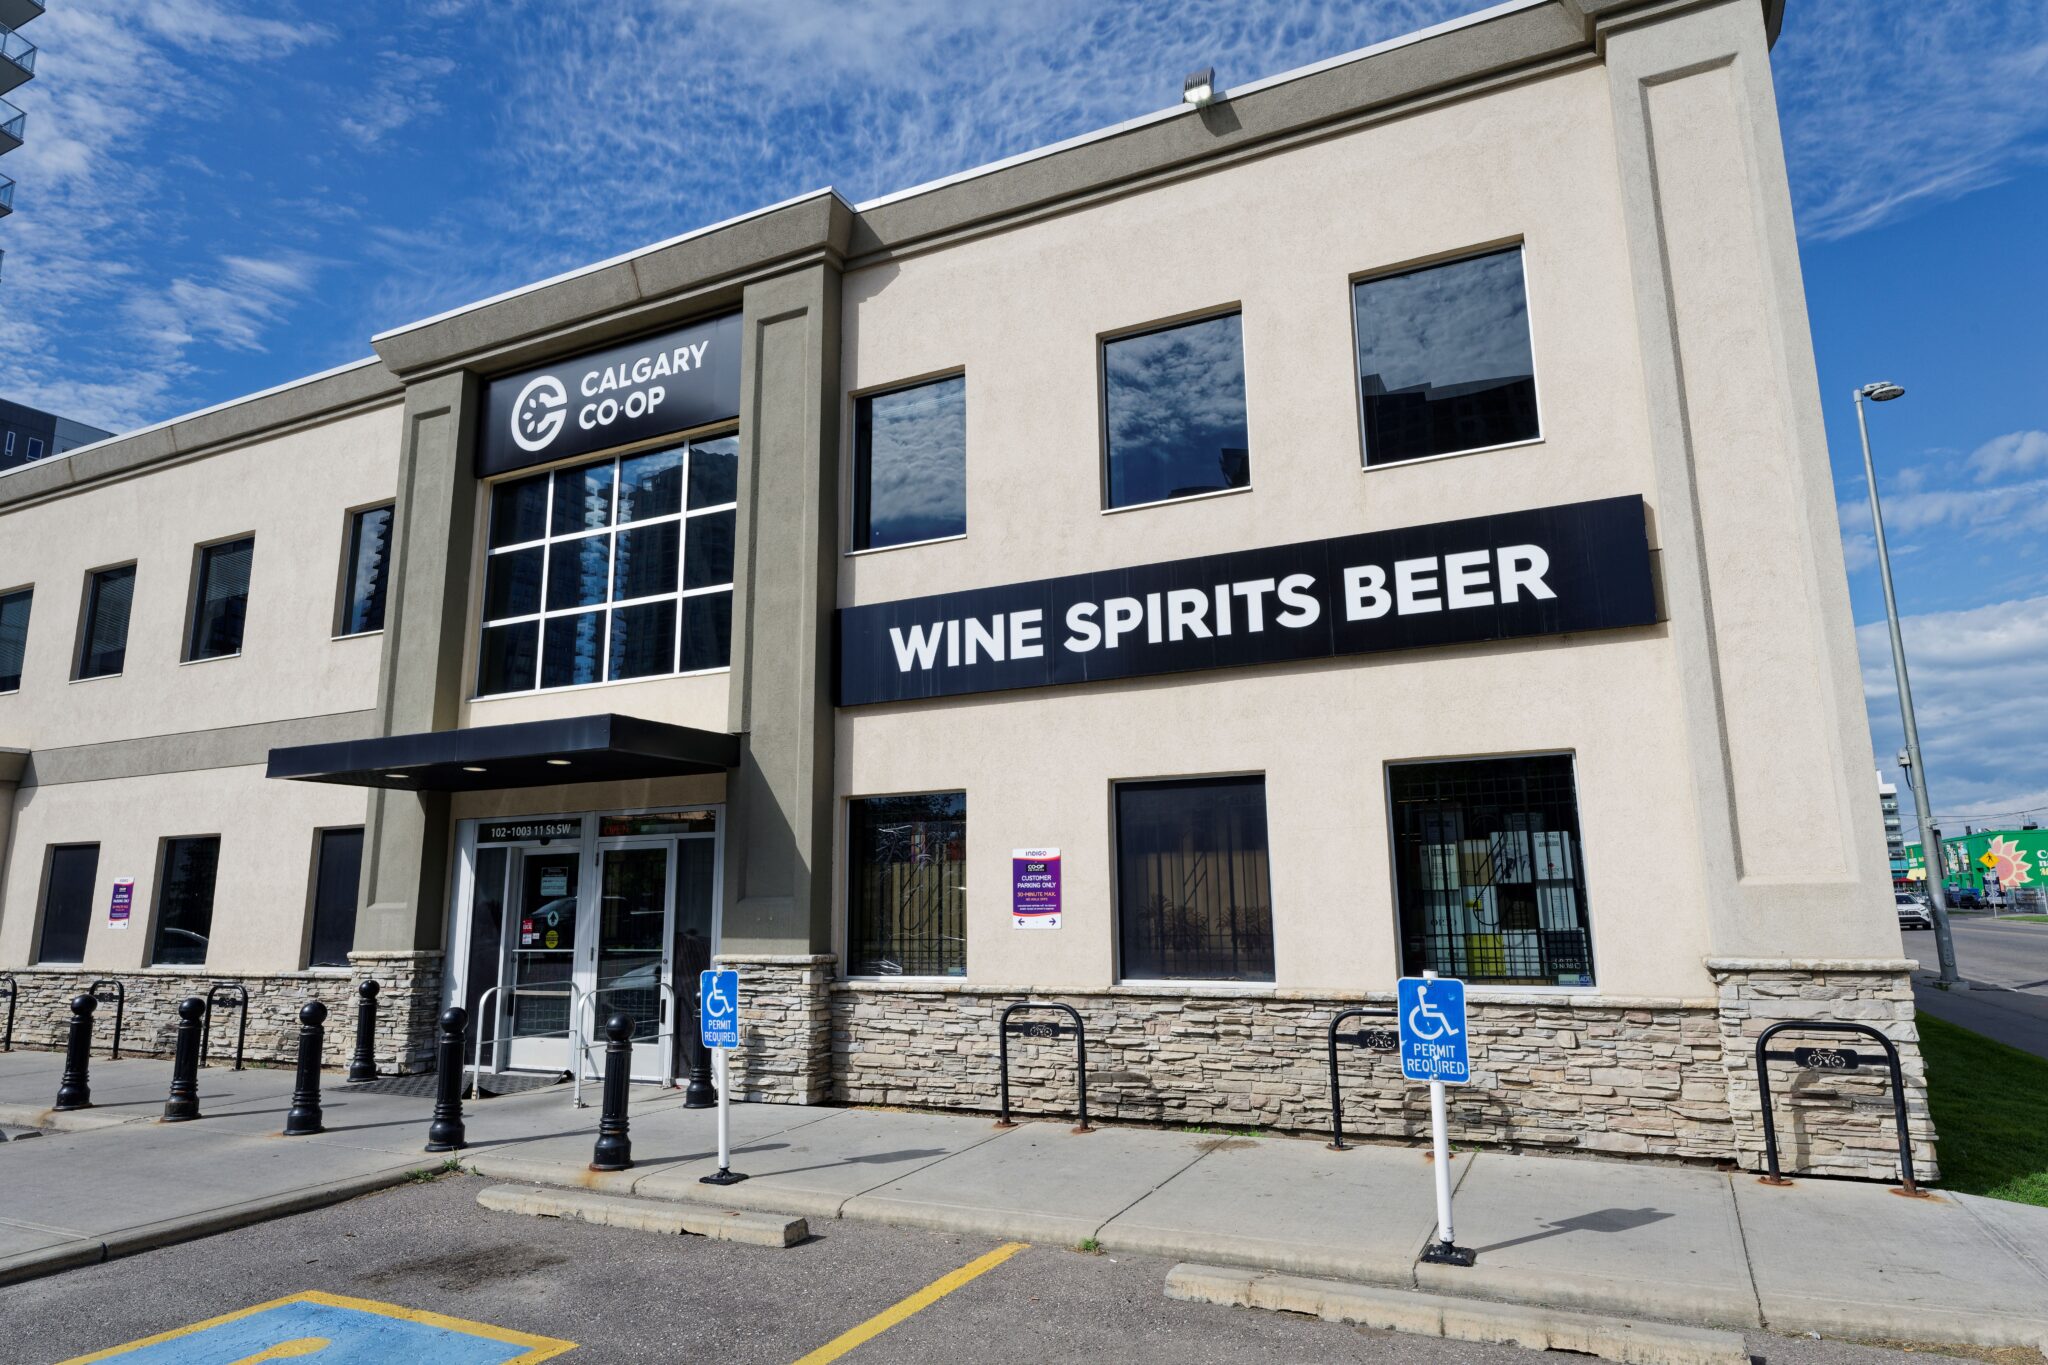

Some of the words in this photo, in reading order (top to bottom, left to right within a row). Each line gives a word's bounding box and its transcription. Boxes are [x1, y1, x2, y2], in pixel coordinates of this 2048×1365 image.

[581, 341, 709, 397] CALGARY
[889, 608, 1044, 672] WINE
[1063, 573, 1321, 653] SPIRITS
[1343, 544, 1558, 621] BEER
[491, 826, 531, 838] 102-1003
[534, 825, 544, 836] 11
[546, 824, 554, 835] St
[556, 824, 571, 835] SW
[708, 1020, 732, 1030] PERMIT
[704, 1031, 736, 1042] REQUIRED
[1413, 1043, 1456, 1058] PERMIT
[1407, 1058, 1465, 1075] REQUIRED
